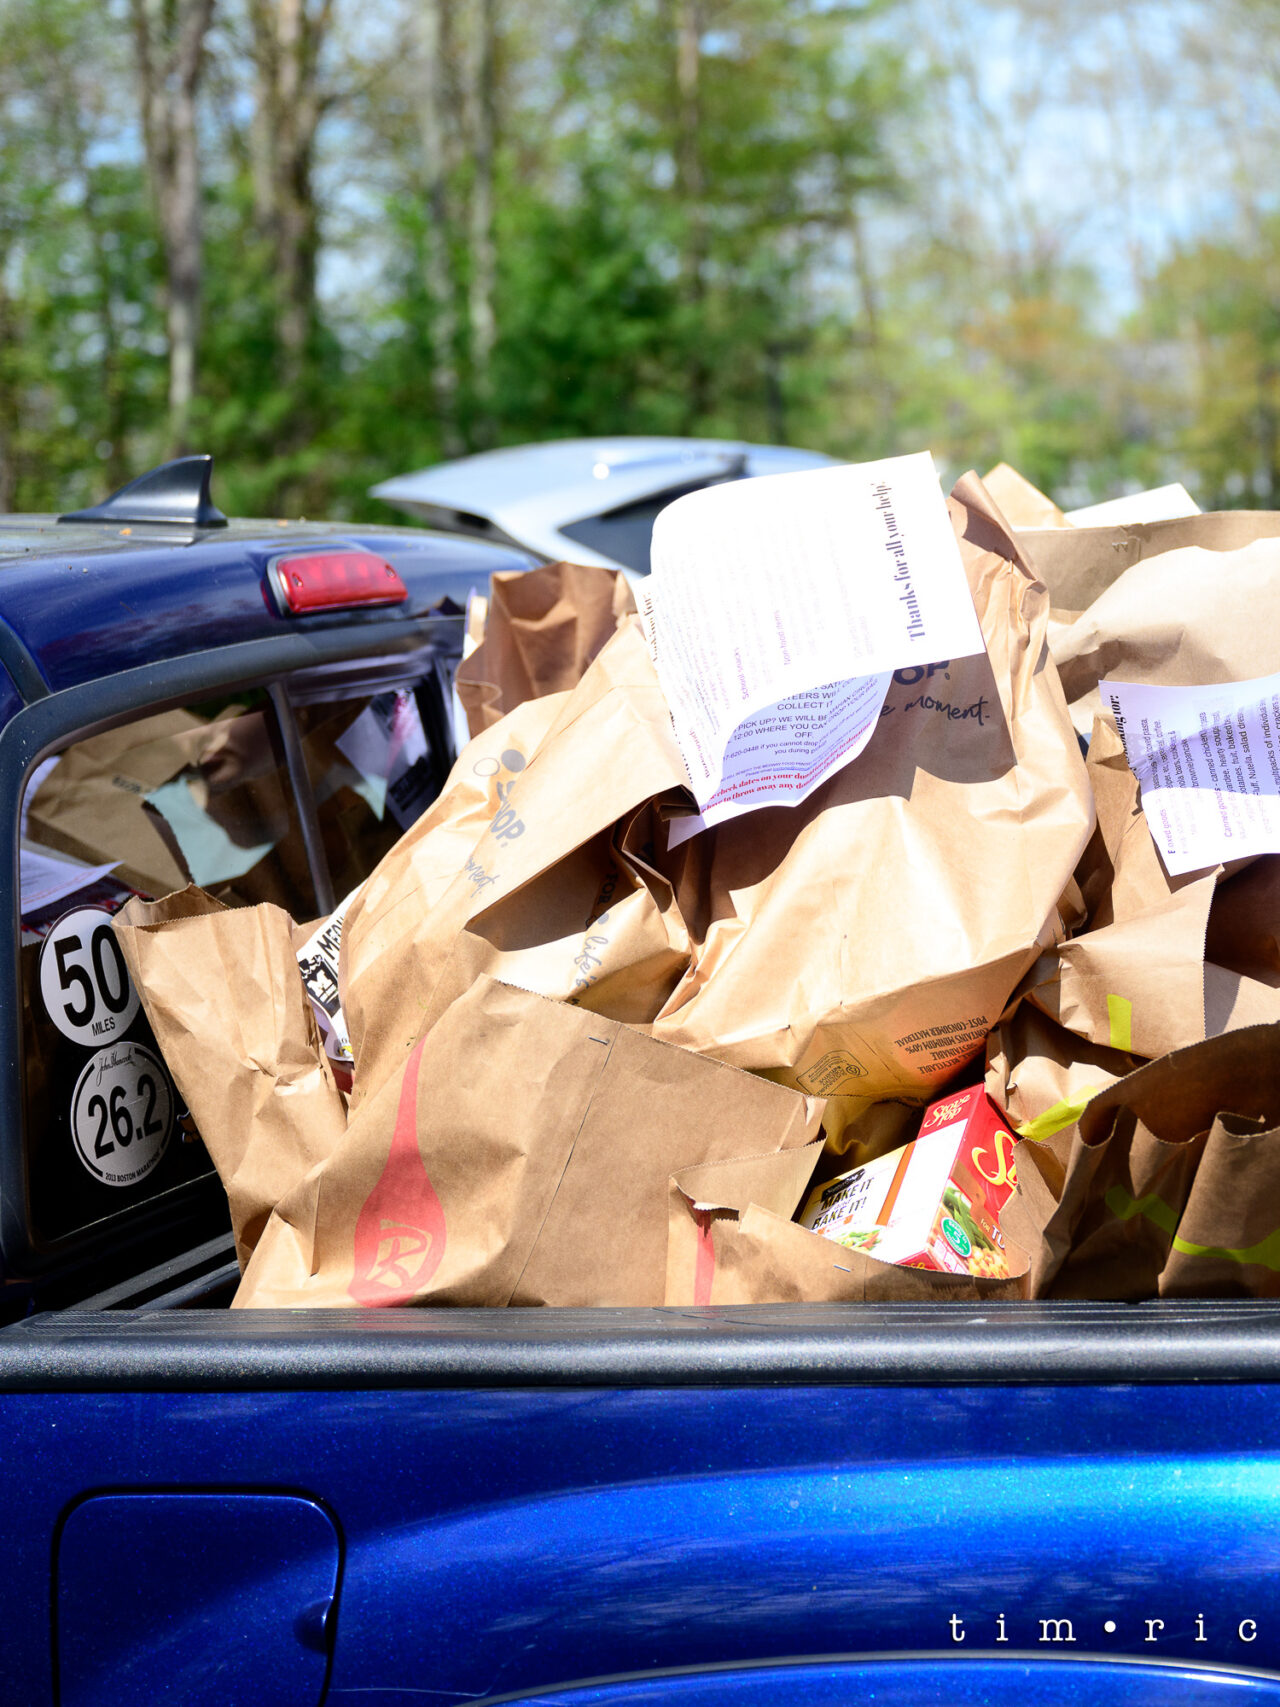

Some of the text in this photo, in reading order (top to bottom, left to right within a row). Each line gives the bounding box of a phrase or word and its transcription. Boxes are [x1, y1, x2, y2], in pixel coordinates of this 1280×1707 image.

[759, 717, 776, 725] UP?
[778, 715, 793, 723] WE
[794, 713, 815, 723] WILL
[776, 698, 822, 714] COLLECT
[905, 696, 990, 726] moment.
[754, 724, 787, 734] WHERE
[790, 722, 809, 731] YOU
[1225, 724, 1235, 749] baked
[1239, 729, 1256, 780] Nutella, salad
[53, 924, 130, 1027] 50
[91, 1017, 116, 1037] MILES
[892, 1015, 988, 1047] POST-CONSUMER MATERIAL
[921, 1035, 955, 1050] MINIMUM
[904, 1042, 923, 1055] 40%
[88, 1074, 163, 1159] 26.2
[924, 1094, 972, 1128] Stove
[105, 1150, 161, 1182] 2013 BOSTON MARATHON
[821, 1184, 858, 1211] MAKE
[857, 1176, 875, 1197] IT
[811, 1196, 868, 1230] BAKE IT!
